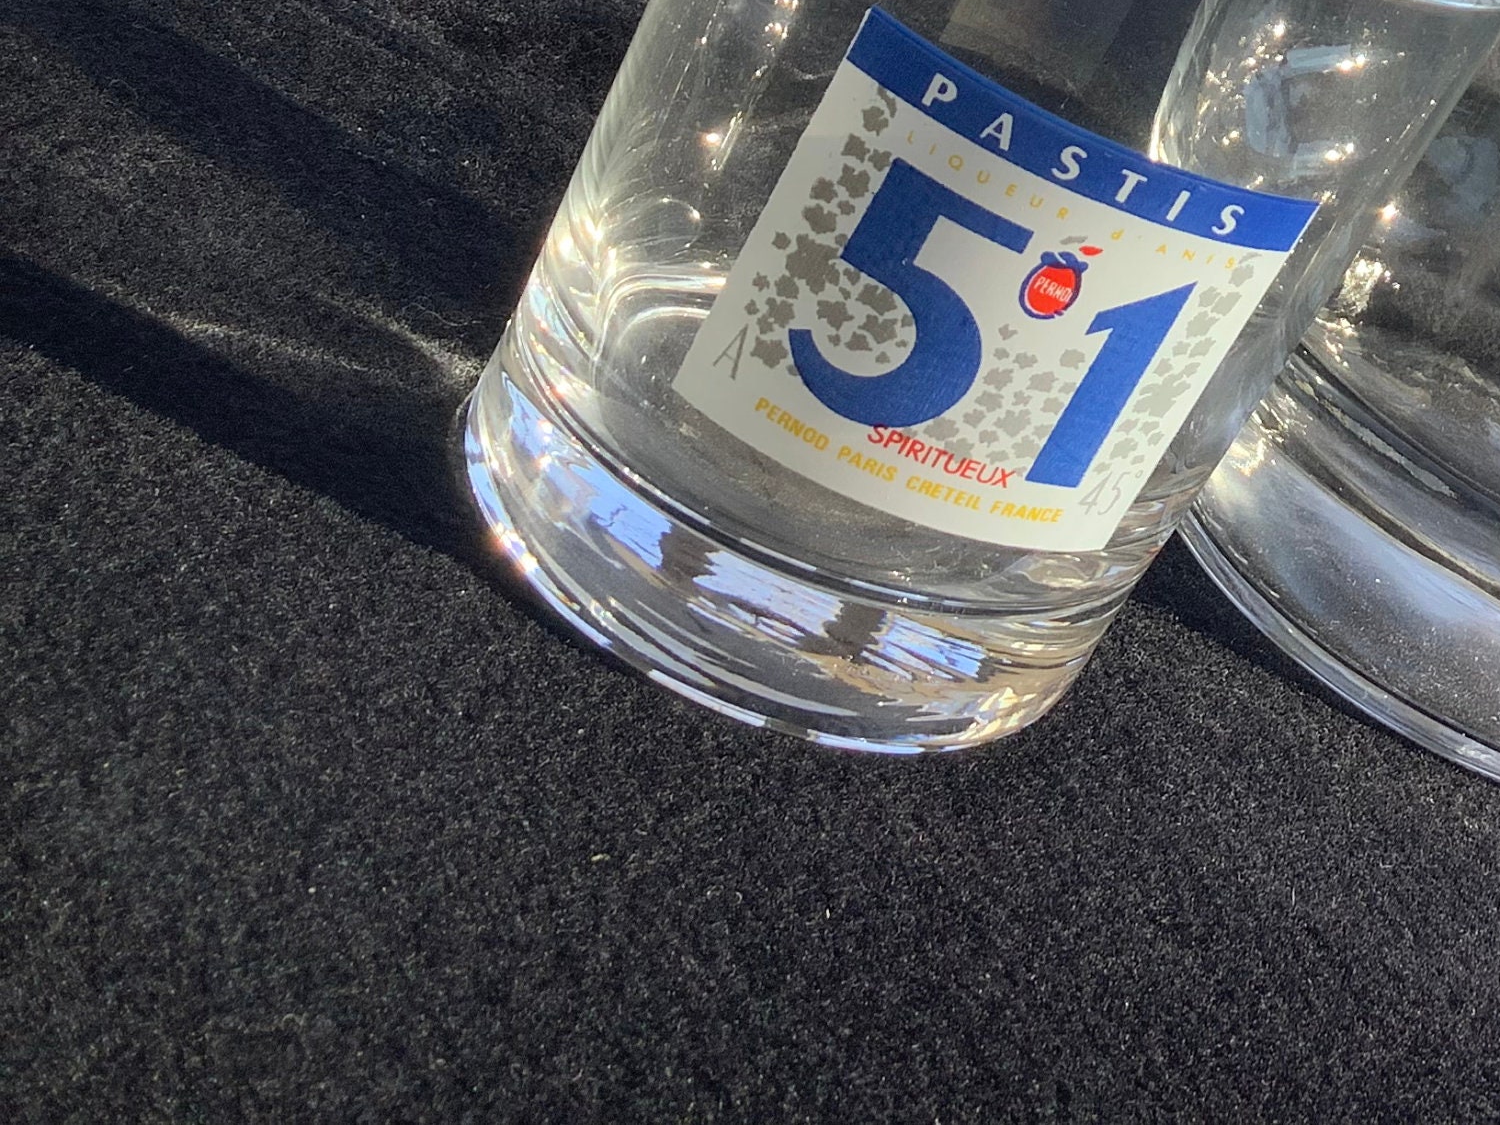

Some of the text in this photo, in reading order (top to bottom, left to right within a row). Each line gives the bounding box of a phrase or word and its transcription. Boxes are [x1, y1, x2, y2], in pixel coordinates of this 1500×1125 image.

[906, 129, 1071, 222] LIQUEUR
[920, 72, 1245, 236] PASTIS
[712, 323, 749, 382] A
[754, 396, 1065, 524] PERNOD PARIS CRETEIL FRANCE
[867, 422, 1017, 489] SPIRITUEUX
